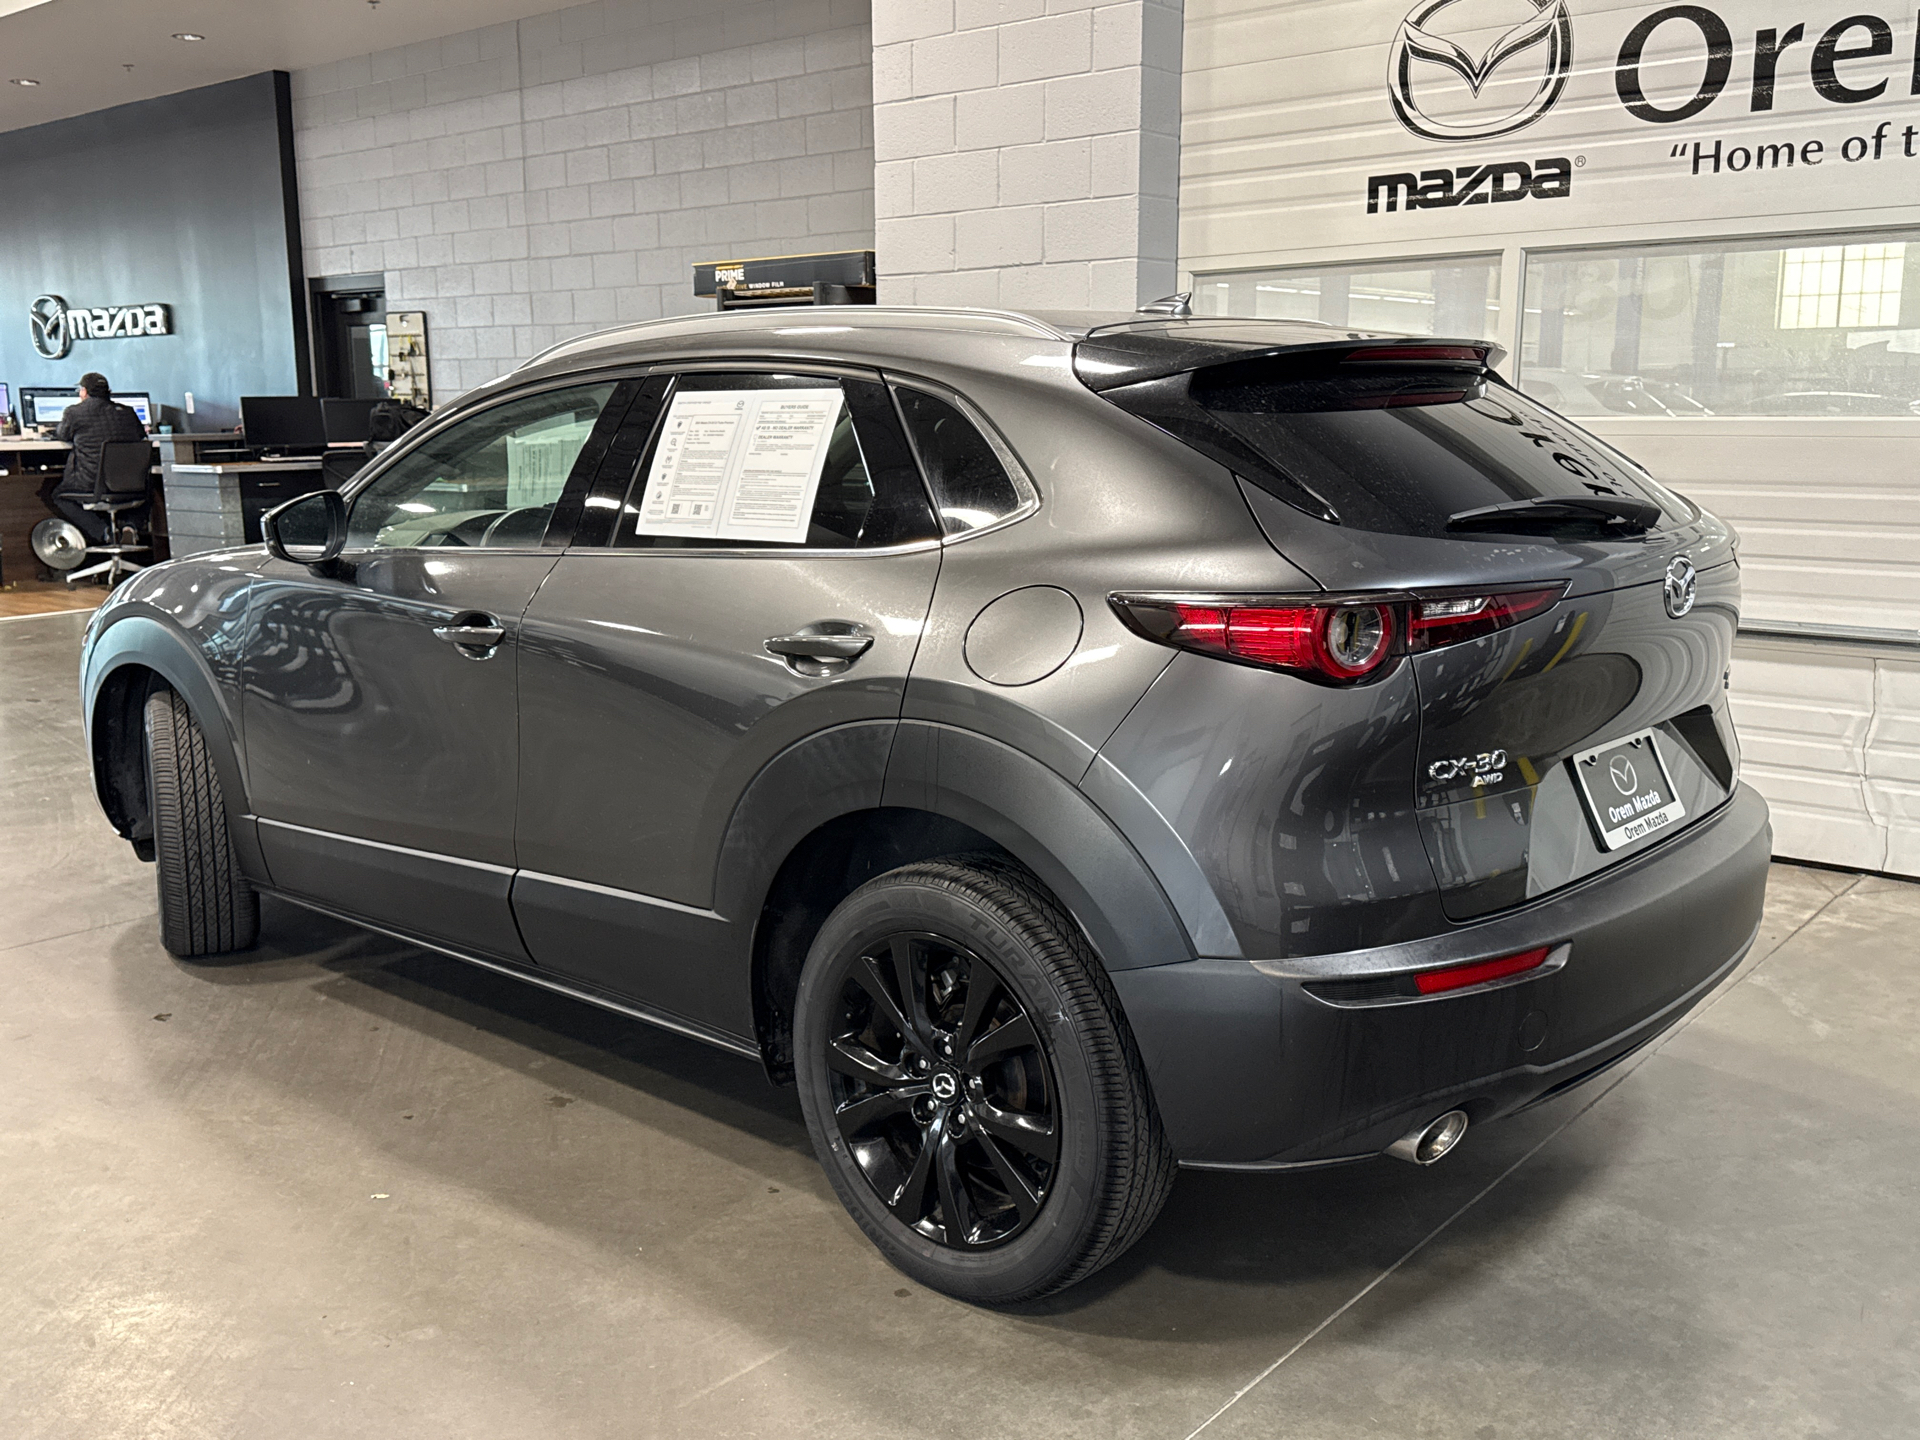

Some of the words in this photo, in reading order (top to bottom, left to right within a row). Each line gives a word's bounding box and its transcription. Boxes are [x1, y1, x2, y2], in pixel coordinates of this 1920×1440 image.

[1614, 5, 1920, 123] Ore
[1841, 121, 1892, 162] of
[715, 268, 745, 282] PRIME
[1428, 749, 1507, 779] CX-30
[1471, 772, 1503, 788] AWD
[1608, 807, 1635, 823] Orem
[1632, 789, 1661, 813] Mazda
[1624, 822, 1647, 840] Orem
[1643, 811, 1669, 831] Mazda
